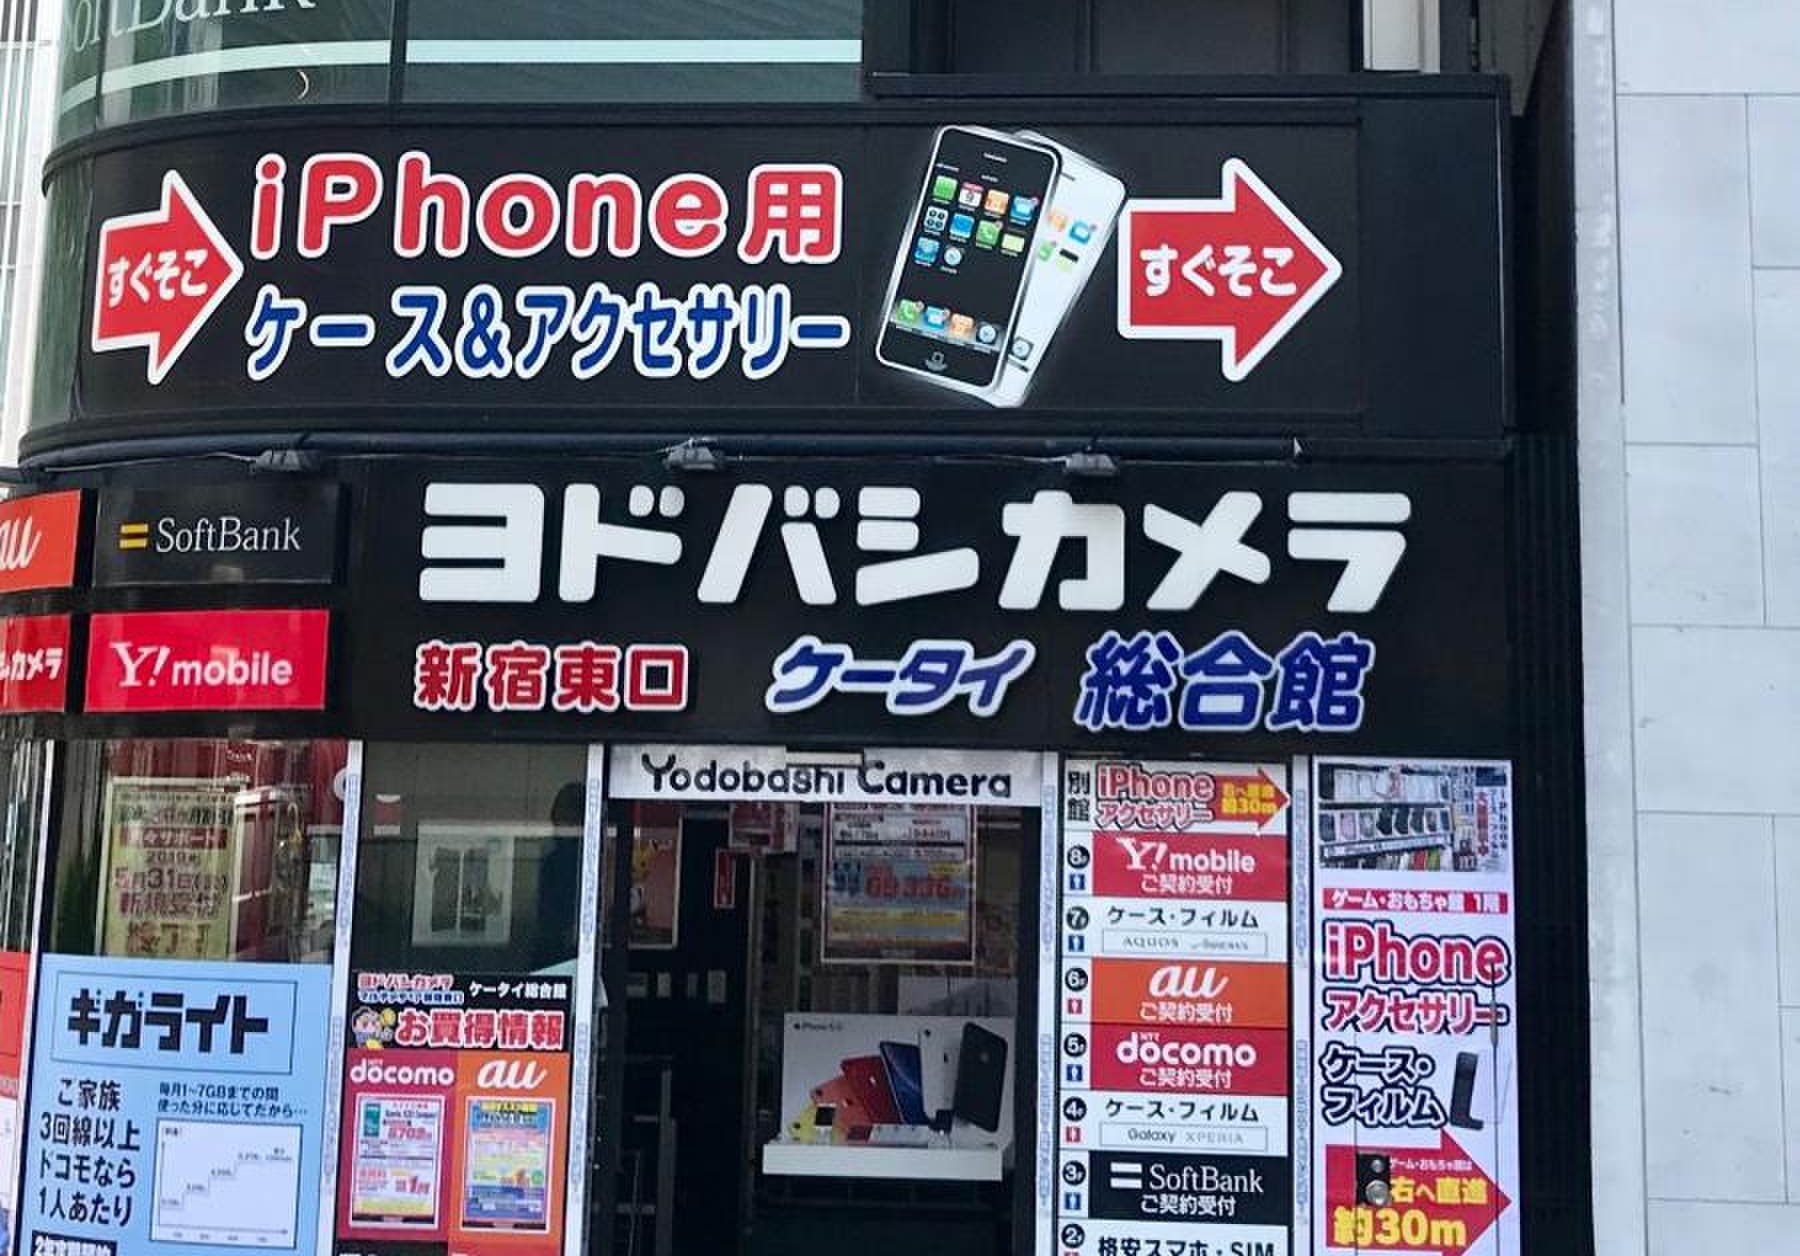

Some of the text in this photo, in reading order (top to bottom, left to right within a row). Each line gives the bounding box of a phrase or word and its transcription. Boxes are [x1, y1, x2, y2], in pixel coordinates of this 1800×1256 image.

[250, 151, 844, 264] iPhone用
[107, 248, 208, 308] すぐそこ
[1140, 244, 1298, 297] すぐそこ
[245, 281, 851, 380] ケース&アクセサリー
[155, 516, 301, 554] SoftBank
[419, 483, 1412, 613] ヨドバシカメラ
[110, 642, 293, 688] Y!mobile
[414, 630, 1377, 733] 新宿東口 ケータイ 総合館
[641, 753, 1013, 799] Yodobashi Camera
[1097, 762, 1216, 801] iPhone
[1096, 800, 1214, 831] アクセサリー
[1116, 837, 1256, 873] Y!mobile
[1140, 873, 1233, 896] ご契約受付
[1107, 905, 1259, 929] ケース・フィルム
[1323, 918, 1512, 988] iPhone
[469, 980, 567, 999] ケータイ総合館
[1149, 965, 1229, 999] au
[67, 987, 269, 1054] ギガライト
[395, 1007, 565, 1049] お買得情報
[1140, 1002, 1233, 1024] ご契約受付
[1323, 987, 1510, 1034] アクセサリー
[1116, 1032, 1257, 1067] docomo
[350, 1058, 455, 1086] docomo
[477, 1059, 548, 1090] au
[1139, 1068, 1233, 1089] ご契約受付
[57, 1078, 121, 1112] ご家族
[1105, 1098, 1259, 1122] ケース・フィルム
[1321, 1085, 1448, 1128] フィルム
[40, 1112, 140, 1152] 3回線以上
[1128, 1128, 1176, 1144] Galaxy
[40, 1148, 136, 1189] ドコモなら
[1150, 1163, 1264, 1194] SoftBank
[39, 1186, 133, 1228] 1人あたり
[1140, 1194, 1237, 1217] ご契約受付
[1333, 1206, 1467, 1247] 約30m
